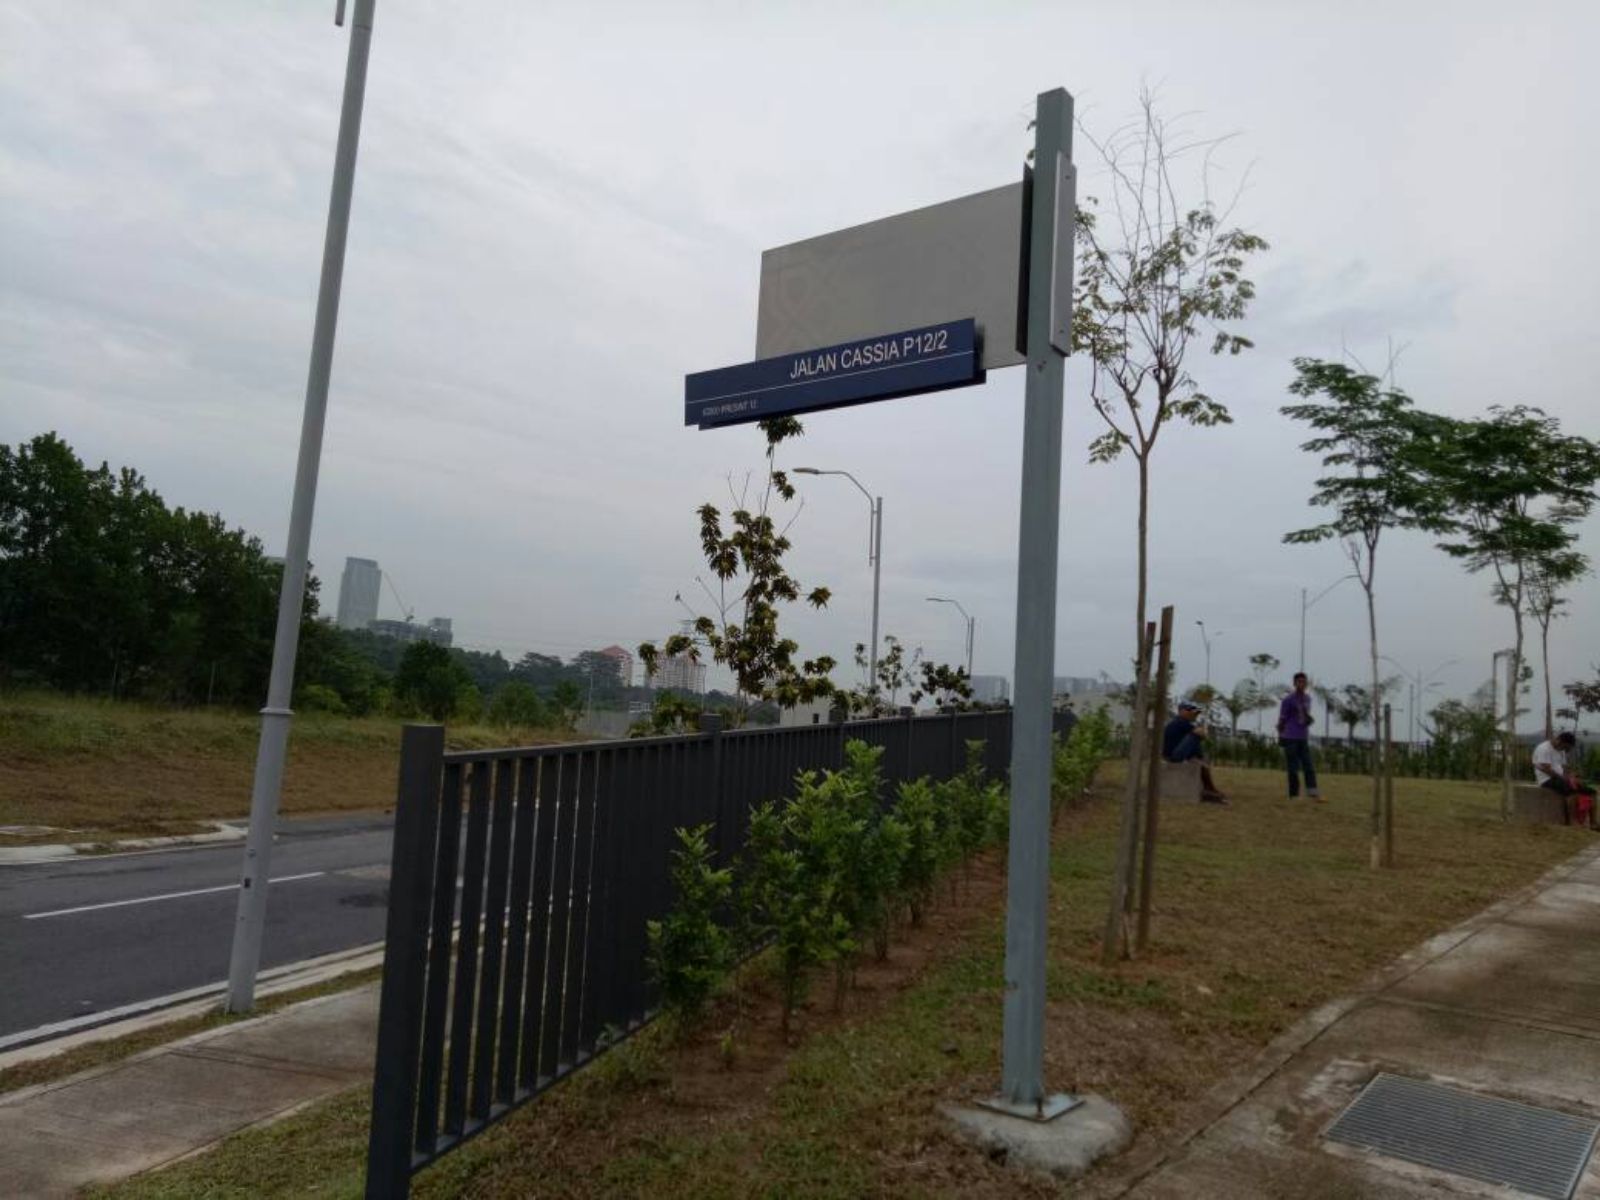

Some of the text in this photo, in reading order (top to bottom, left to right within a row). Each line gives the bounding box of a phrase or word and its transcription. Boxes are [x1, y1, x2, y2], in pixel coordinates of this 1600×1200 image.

[790, 330, 948, 379] JALAN CASSIA P12/2
